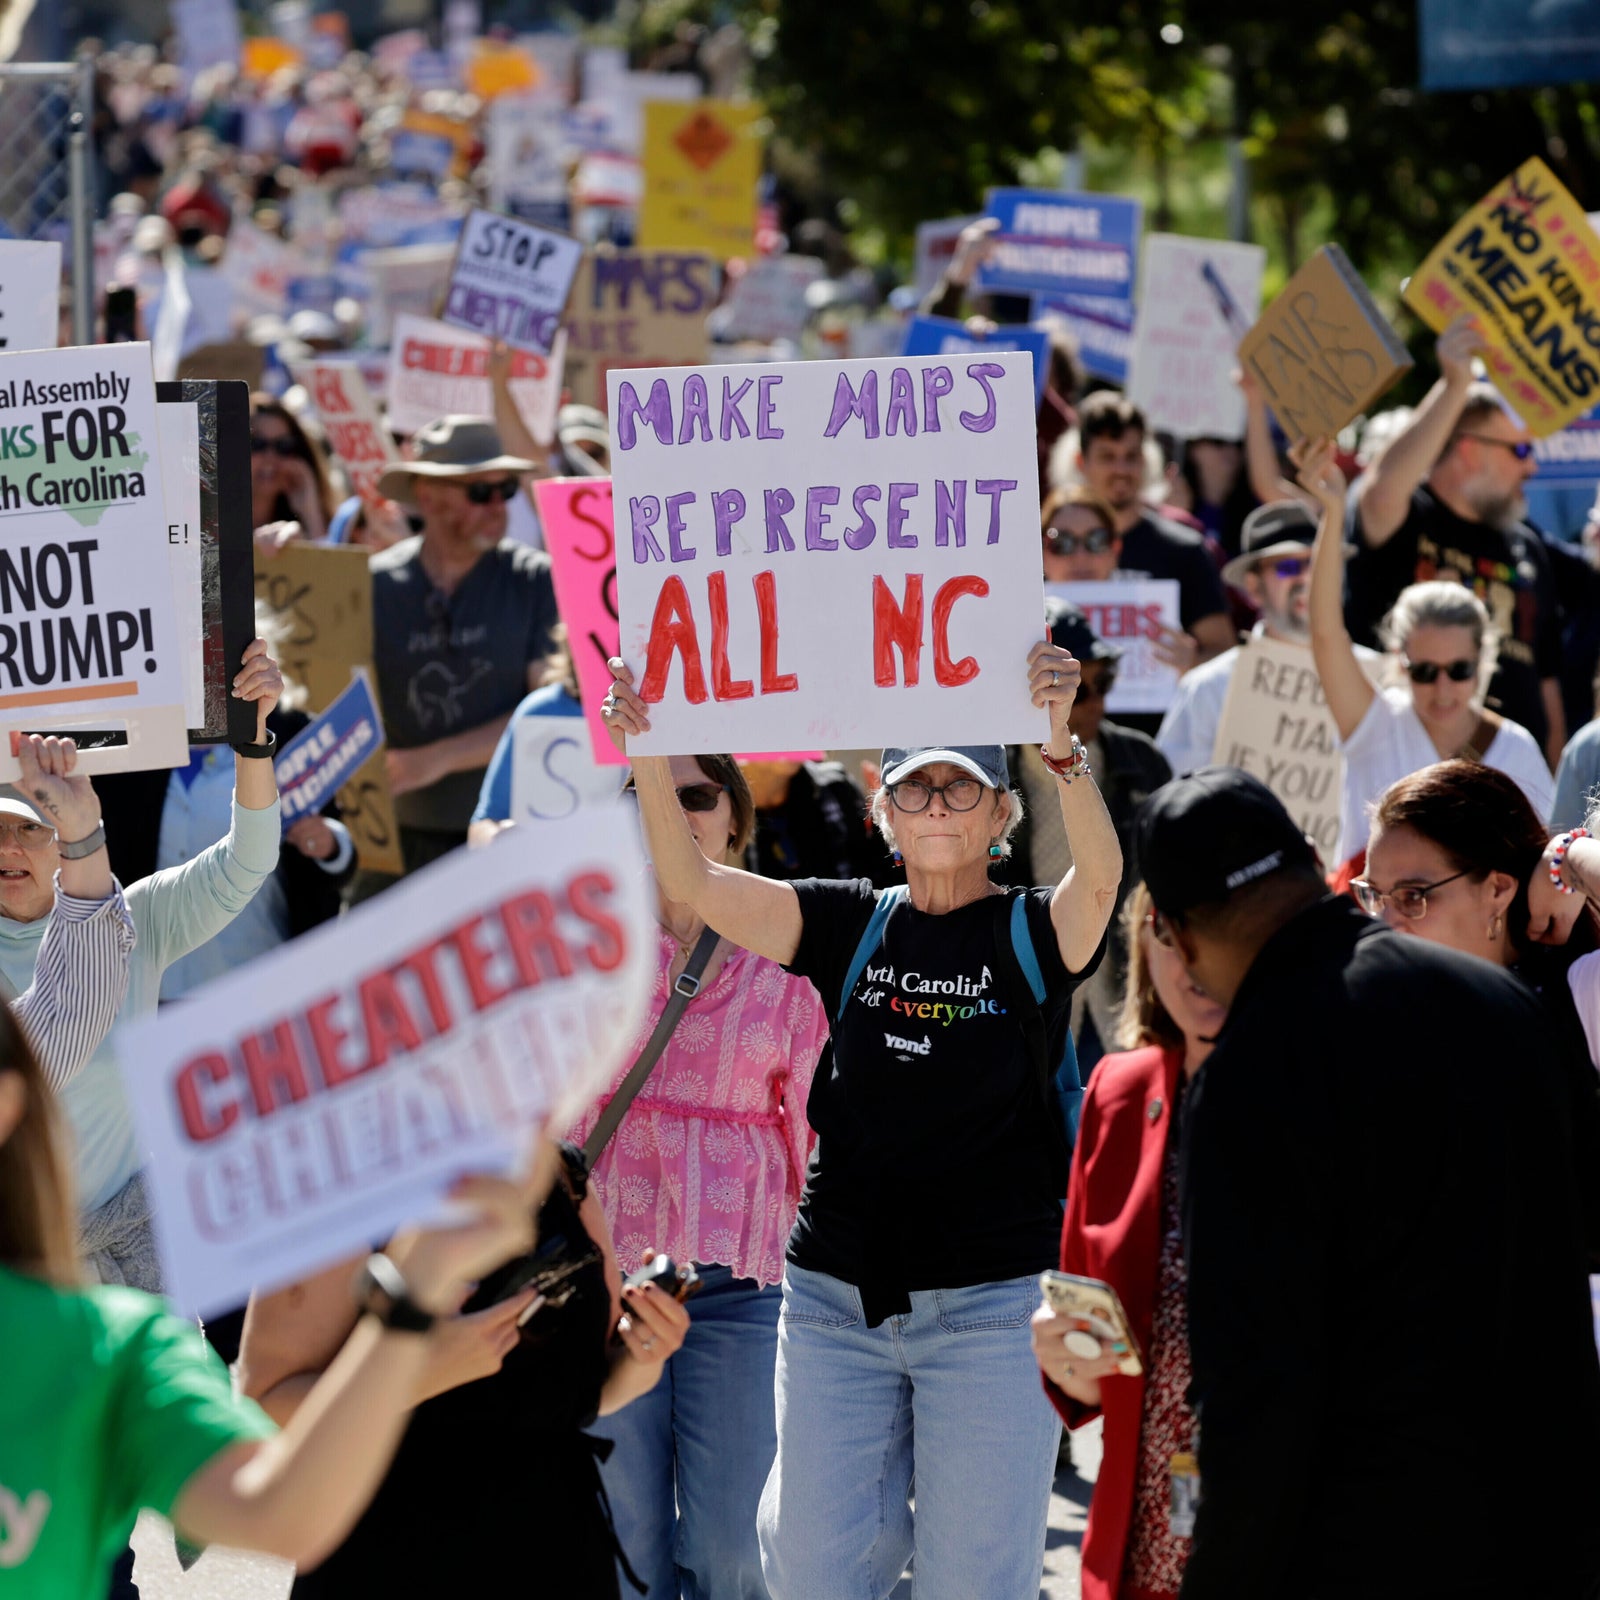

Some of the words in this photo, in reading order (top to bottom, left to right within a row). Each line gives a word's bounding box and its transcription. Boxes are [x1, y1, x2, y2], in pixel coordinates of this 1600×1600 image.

[474, 222, 559, 271] STOP
[1488, 203, 1542, 255] NO
[1453, 226, 1600, 398] MEANS
[22, 371, 131, 405] Assembly
[617, 374, 785, 451] MAKE
[823, 363, 1006, 440] MAPS
[0, 424, 38, 460] KS
[42, 405, 131, 464] FOR
[0, 475, 21, 511] h
[26, 466, 147, 507] Carolina
[629, 479, 1018, 564] REPRESENT
[0, 539, 98, 614] NOT
[639, 569, 799, 705] ALL
[872, 573, 990, 689] NC
[1080, 604, 1165, 641] TERS
[276, 722, 337, 786] OPLE
[1273, 712, 1334, 756] MA
[1264, 753, 1335, 804] YOU
[169, 868, 631, 1145] CHEATERS
[901, 965, 993, 997] Carolin
[890, 996, 1008, 1027] everyone.
